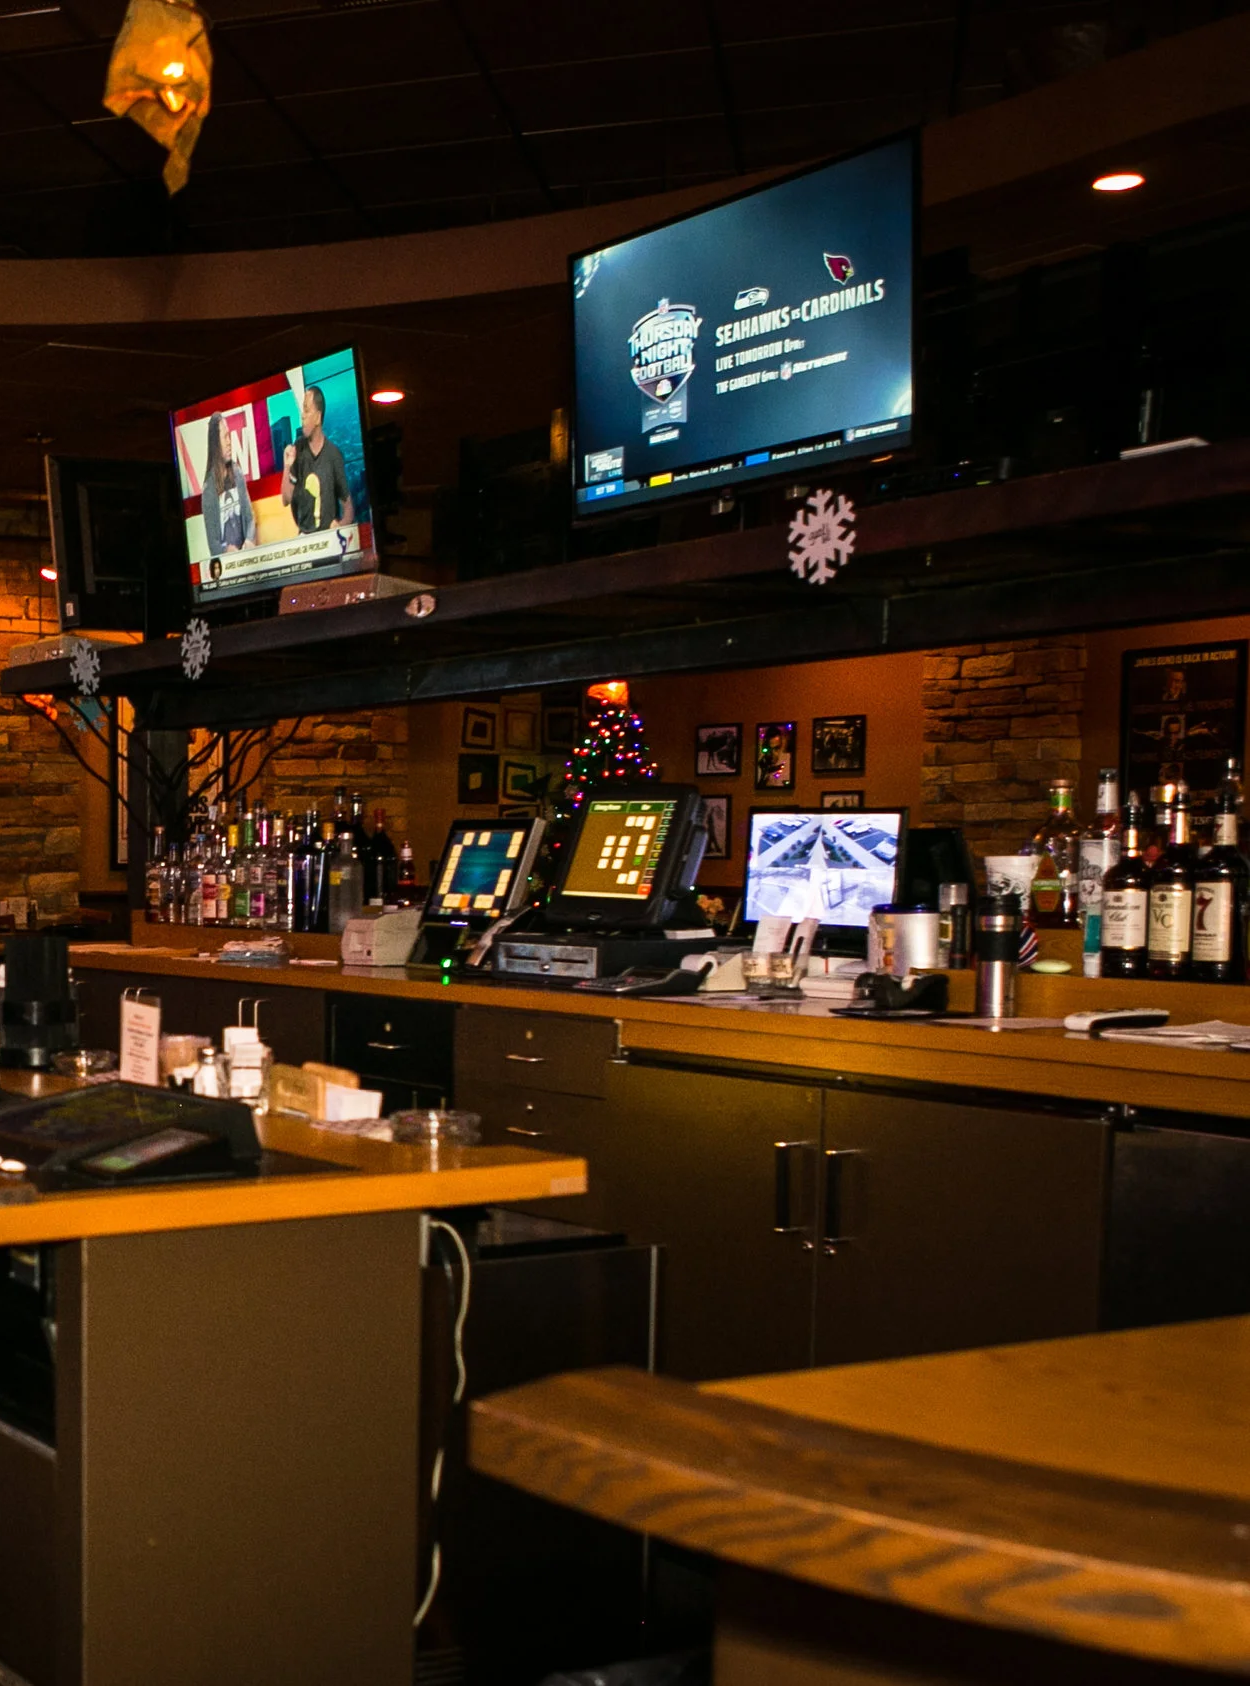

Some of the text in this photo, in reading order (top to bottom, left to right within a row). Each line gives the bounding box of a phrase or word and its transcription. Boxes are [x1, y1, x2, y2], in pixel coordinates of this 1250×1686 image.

[715, 306, 790, 347] SEAHAWKS
[801, 279, 884, 322] CARDINALS
[627, 317, 703, 357] THURSDAY
[639, 339, 694, 364] NIGHT
[631, 352, 695, 383] FOOTBALL
[716, 355, 734, 372] LIVE
[735, 340, 783, 367] TOMORROW
